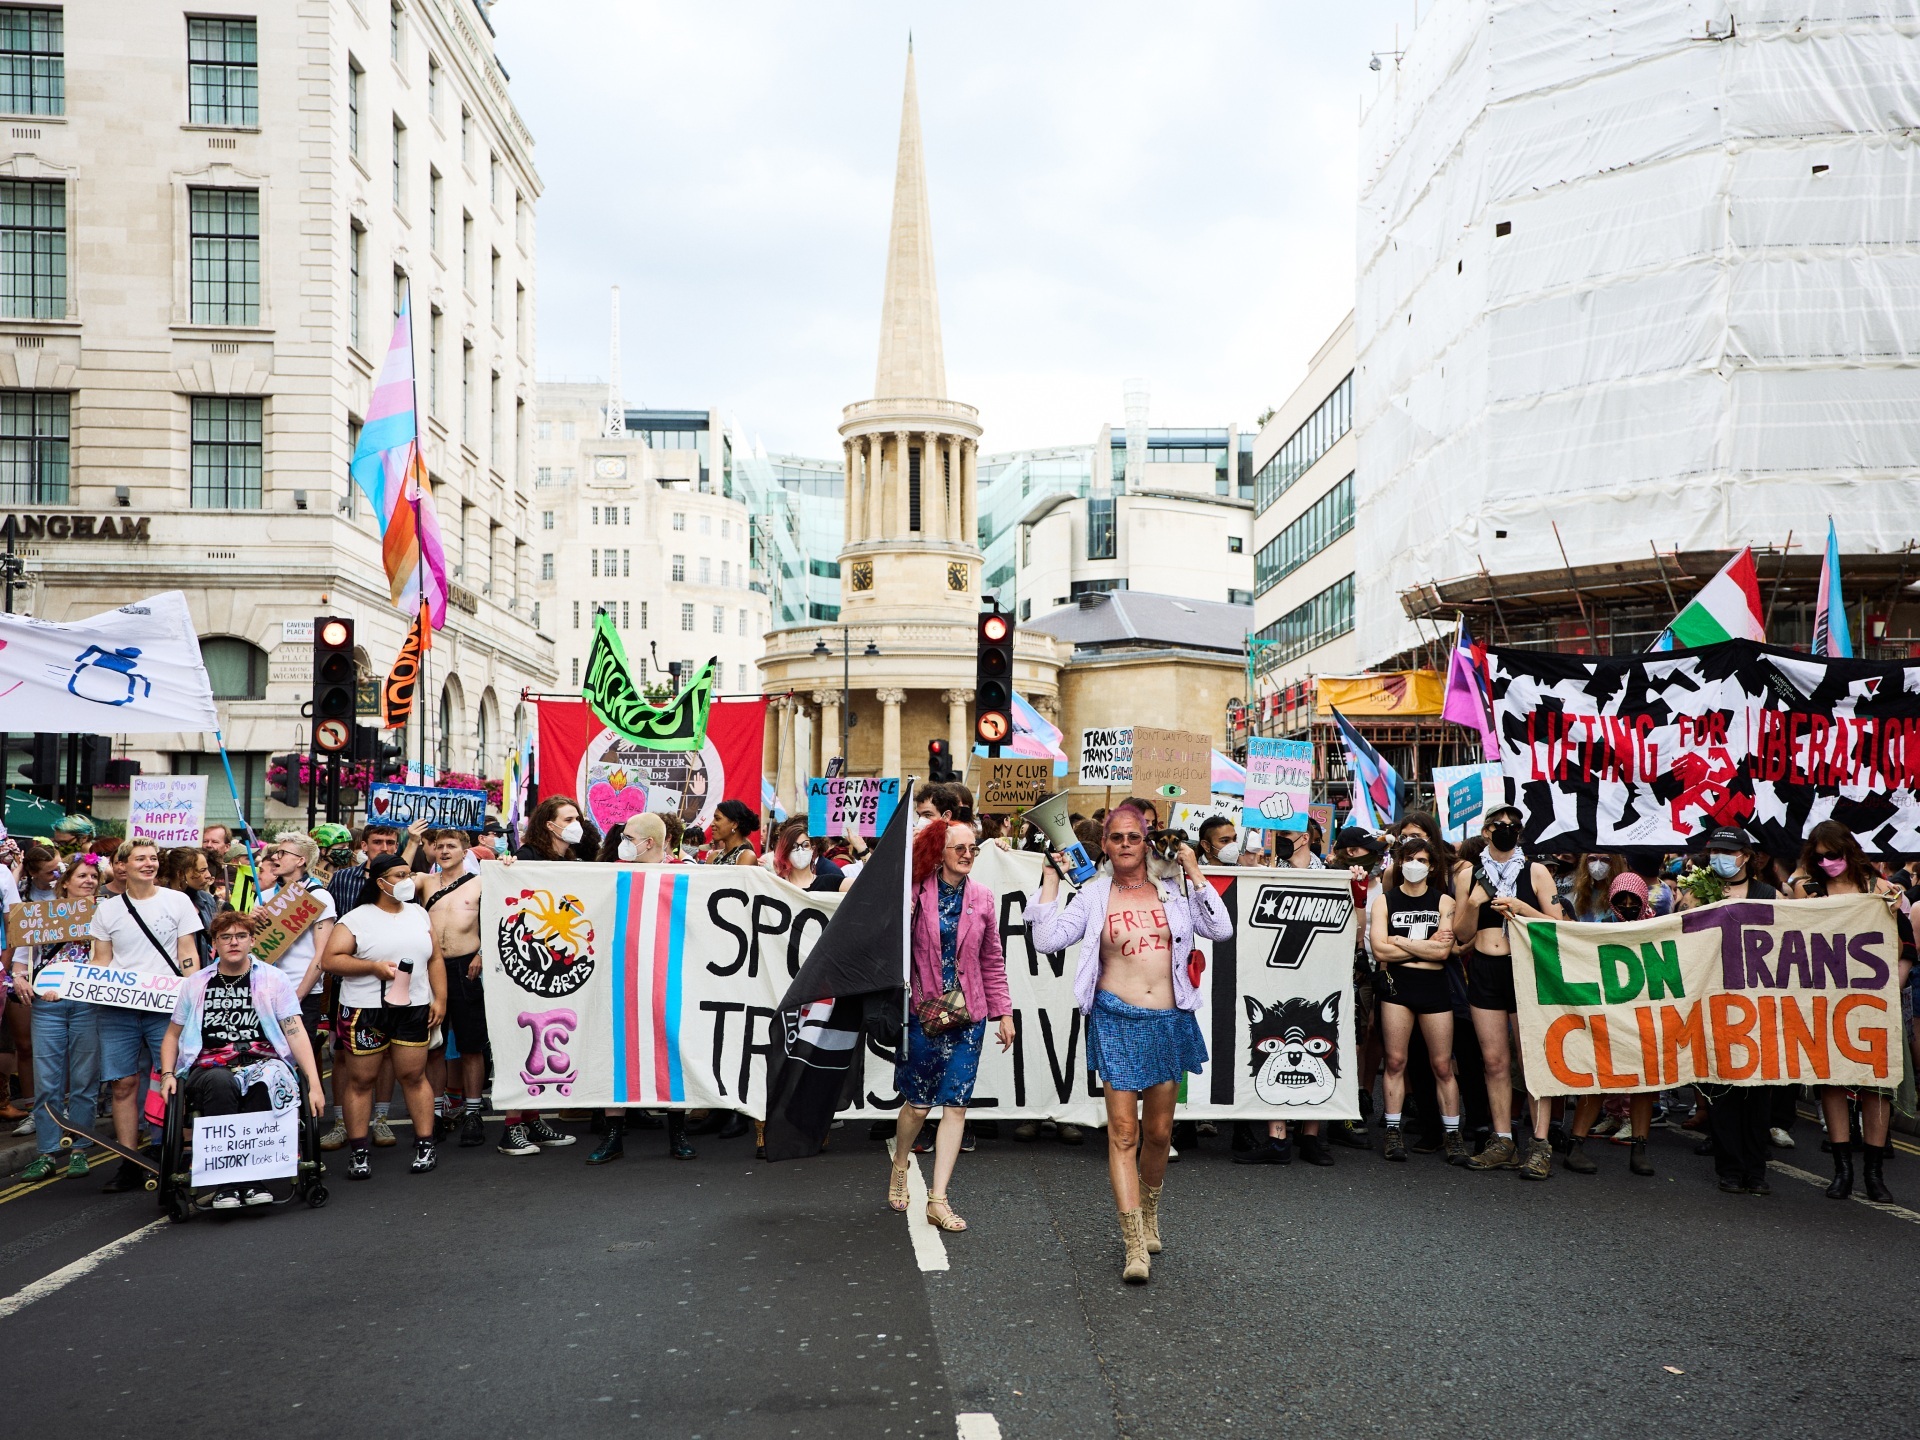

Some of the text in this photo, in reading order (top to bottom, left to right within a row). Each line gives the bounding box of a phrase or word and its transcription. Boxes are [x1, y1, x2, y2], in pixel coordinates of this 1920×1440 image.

[282, 654, 308, 662] PLACE
[1084, 729, 1134, 747] TRANS JO
[1196, 734, 1208, 743] SEE
[1029, 749, 1042, 757] FIND
[1083, 747, 1133, 763] TRANS LOV
[1249, 740, 1311, 764] PROTECTOR
[1527, 706, 1920, 789] LIFTING FOR LIBERATION
[619, 758, 685, 767] MANCHESTER
[1254, 761, 1270, 772] OF
[993, 764, 1048, 779] MY CLUB
[1082, 764, 1109, 779] TRANS
[1253, 765, 1310, 787] THE DOLLS
[134, 779, 166, 791] PROUD
[811, 780, 898, 796] ACCEPTANCE
[1003, 780, 1031, 789] IS MY
[1453, 785, 1470, 799] TRANS
[835, 796, 878, 809] SAVES
[985, 790, 1048, 802] COMMUNIT
[1453, 796, 1463, 808] JOY
[387, 791, 483, 827] TESTOSTERONE
[1453, 800, 1483, 820] RESISTANCE
[145, 812, 187, 824] HAPPY
[832, 811, 876, 825] LIVES
[134, 826, 199, 841] DAUGHTER
[267, 883, 304, 917] LOVE
[23, 900, 88, 919] WE LOVE
[1277, 895, 1350, 924] CLIMBING
[20, 918, 44, 929] OUR
[1108, 909, 1169, 943] FREE
[1403, 913, 1438, 924] CLIMBING
[22, 923, 91, 944] TRANS CHI
[250, 928, 286, 962] RANS
[281, 899, 318, 935] RAGE
[501, 931, 592, 994] MARTIAL ARTS
[1527, 903, 1890, 1006] LDN TRANS
[74, 965, 182, 991] TRANS JOY
[65, 981, 178, 1010] IS RESISTANCE
[204, 999, 252, 1010] PEOPL
[204, 1010, 259, 1028] BELONG
[1545, 992, 1888, 1088] CLIMBING
[202, 1121, 280, 1139] THIS is what
[204, 1136, 287, 1153] the RIGHT side of
[205, 1153, 250, 1171] HISTORY
